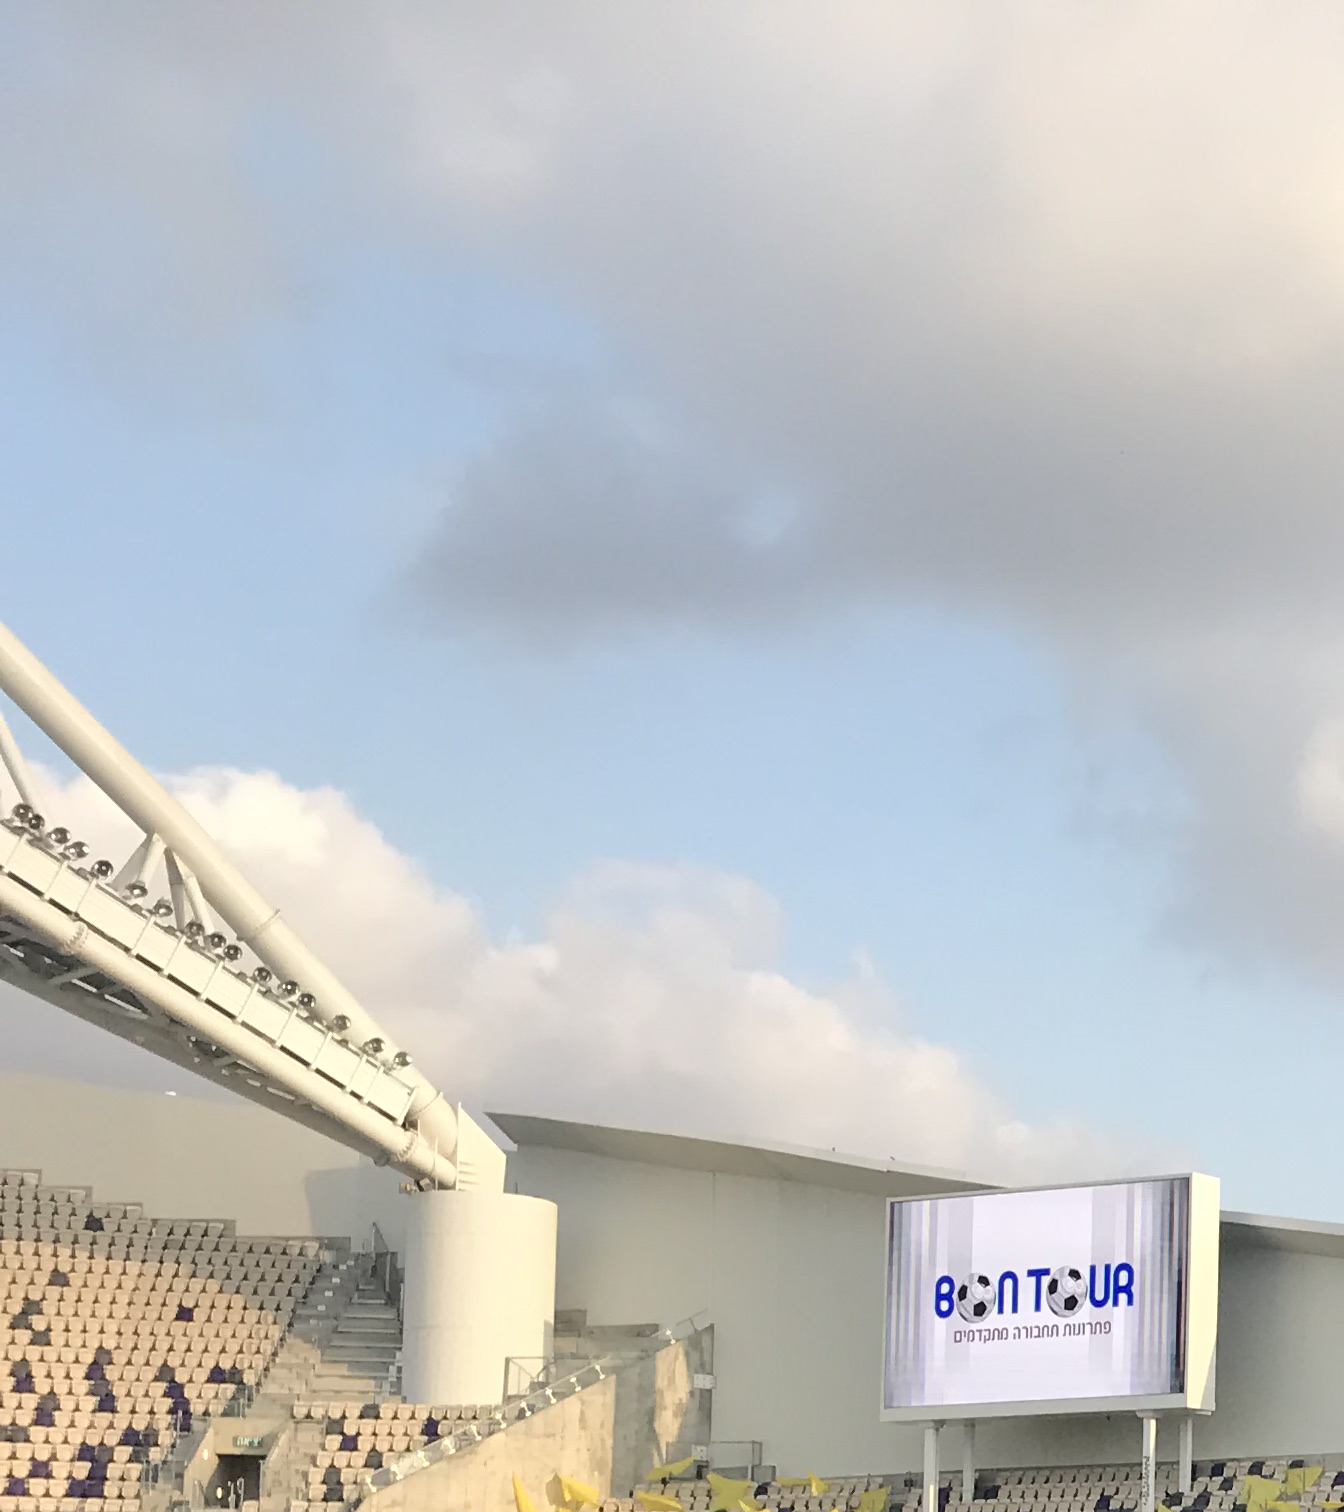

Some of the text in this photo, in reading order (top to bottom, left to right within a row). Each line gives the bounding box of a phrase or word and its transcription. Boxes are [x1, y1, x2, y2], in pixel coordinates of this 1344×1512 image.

[1026, 1261, 1135, 1319] TOUR
[953, 1320, 1112, 1344] פתרונות תחבורה מתקדמים
